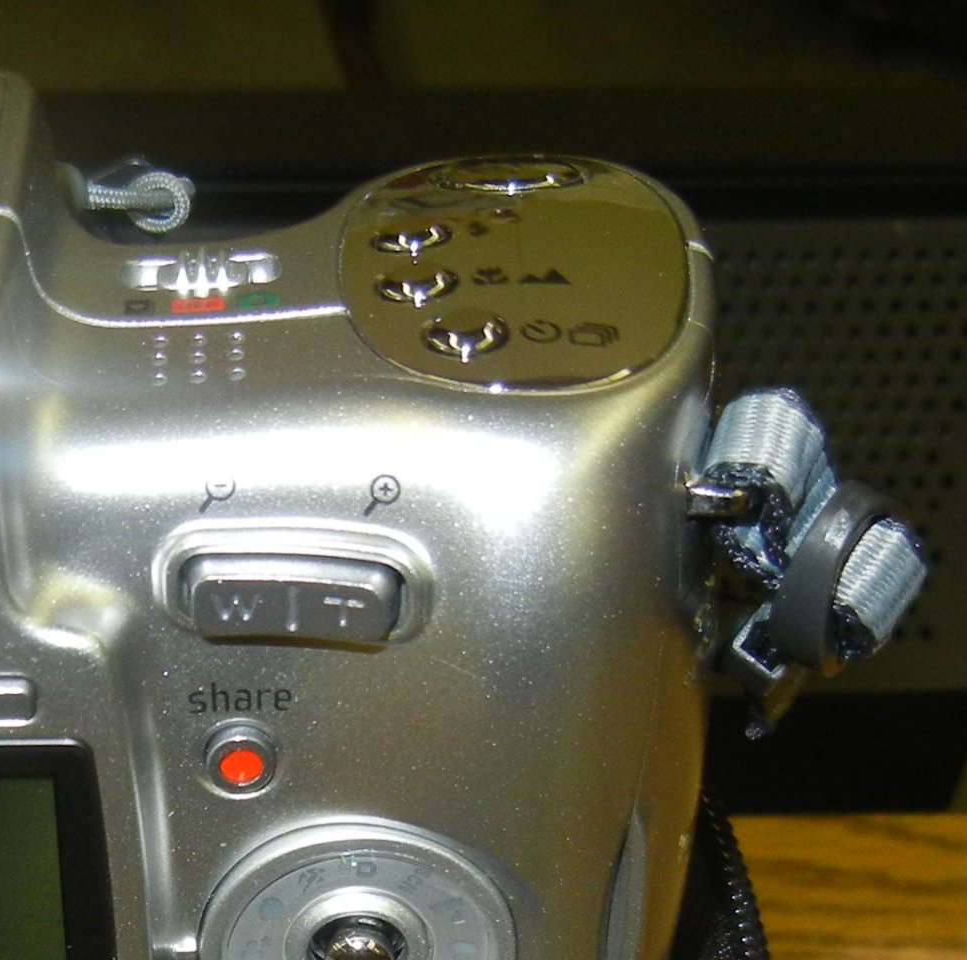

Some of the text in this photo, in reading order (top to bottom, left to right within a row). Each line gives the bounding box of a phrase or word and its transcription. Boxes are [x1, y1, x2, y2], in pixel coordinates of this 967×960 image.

[211, 593, 366, 627] W T
[187, 682, 293, 714] share
